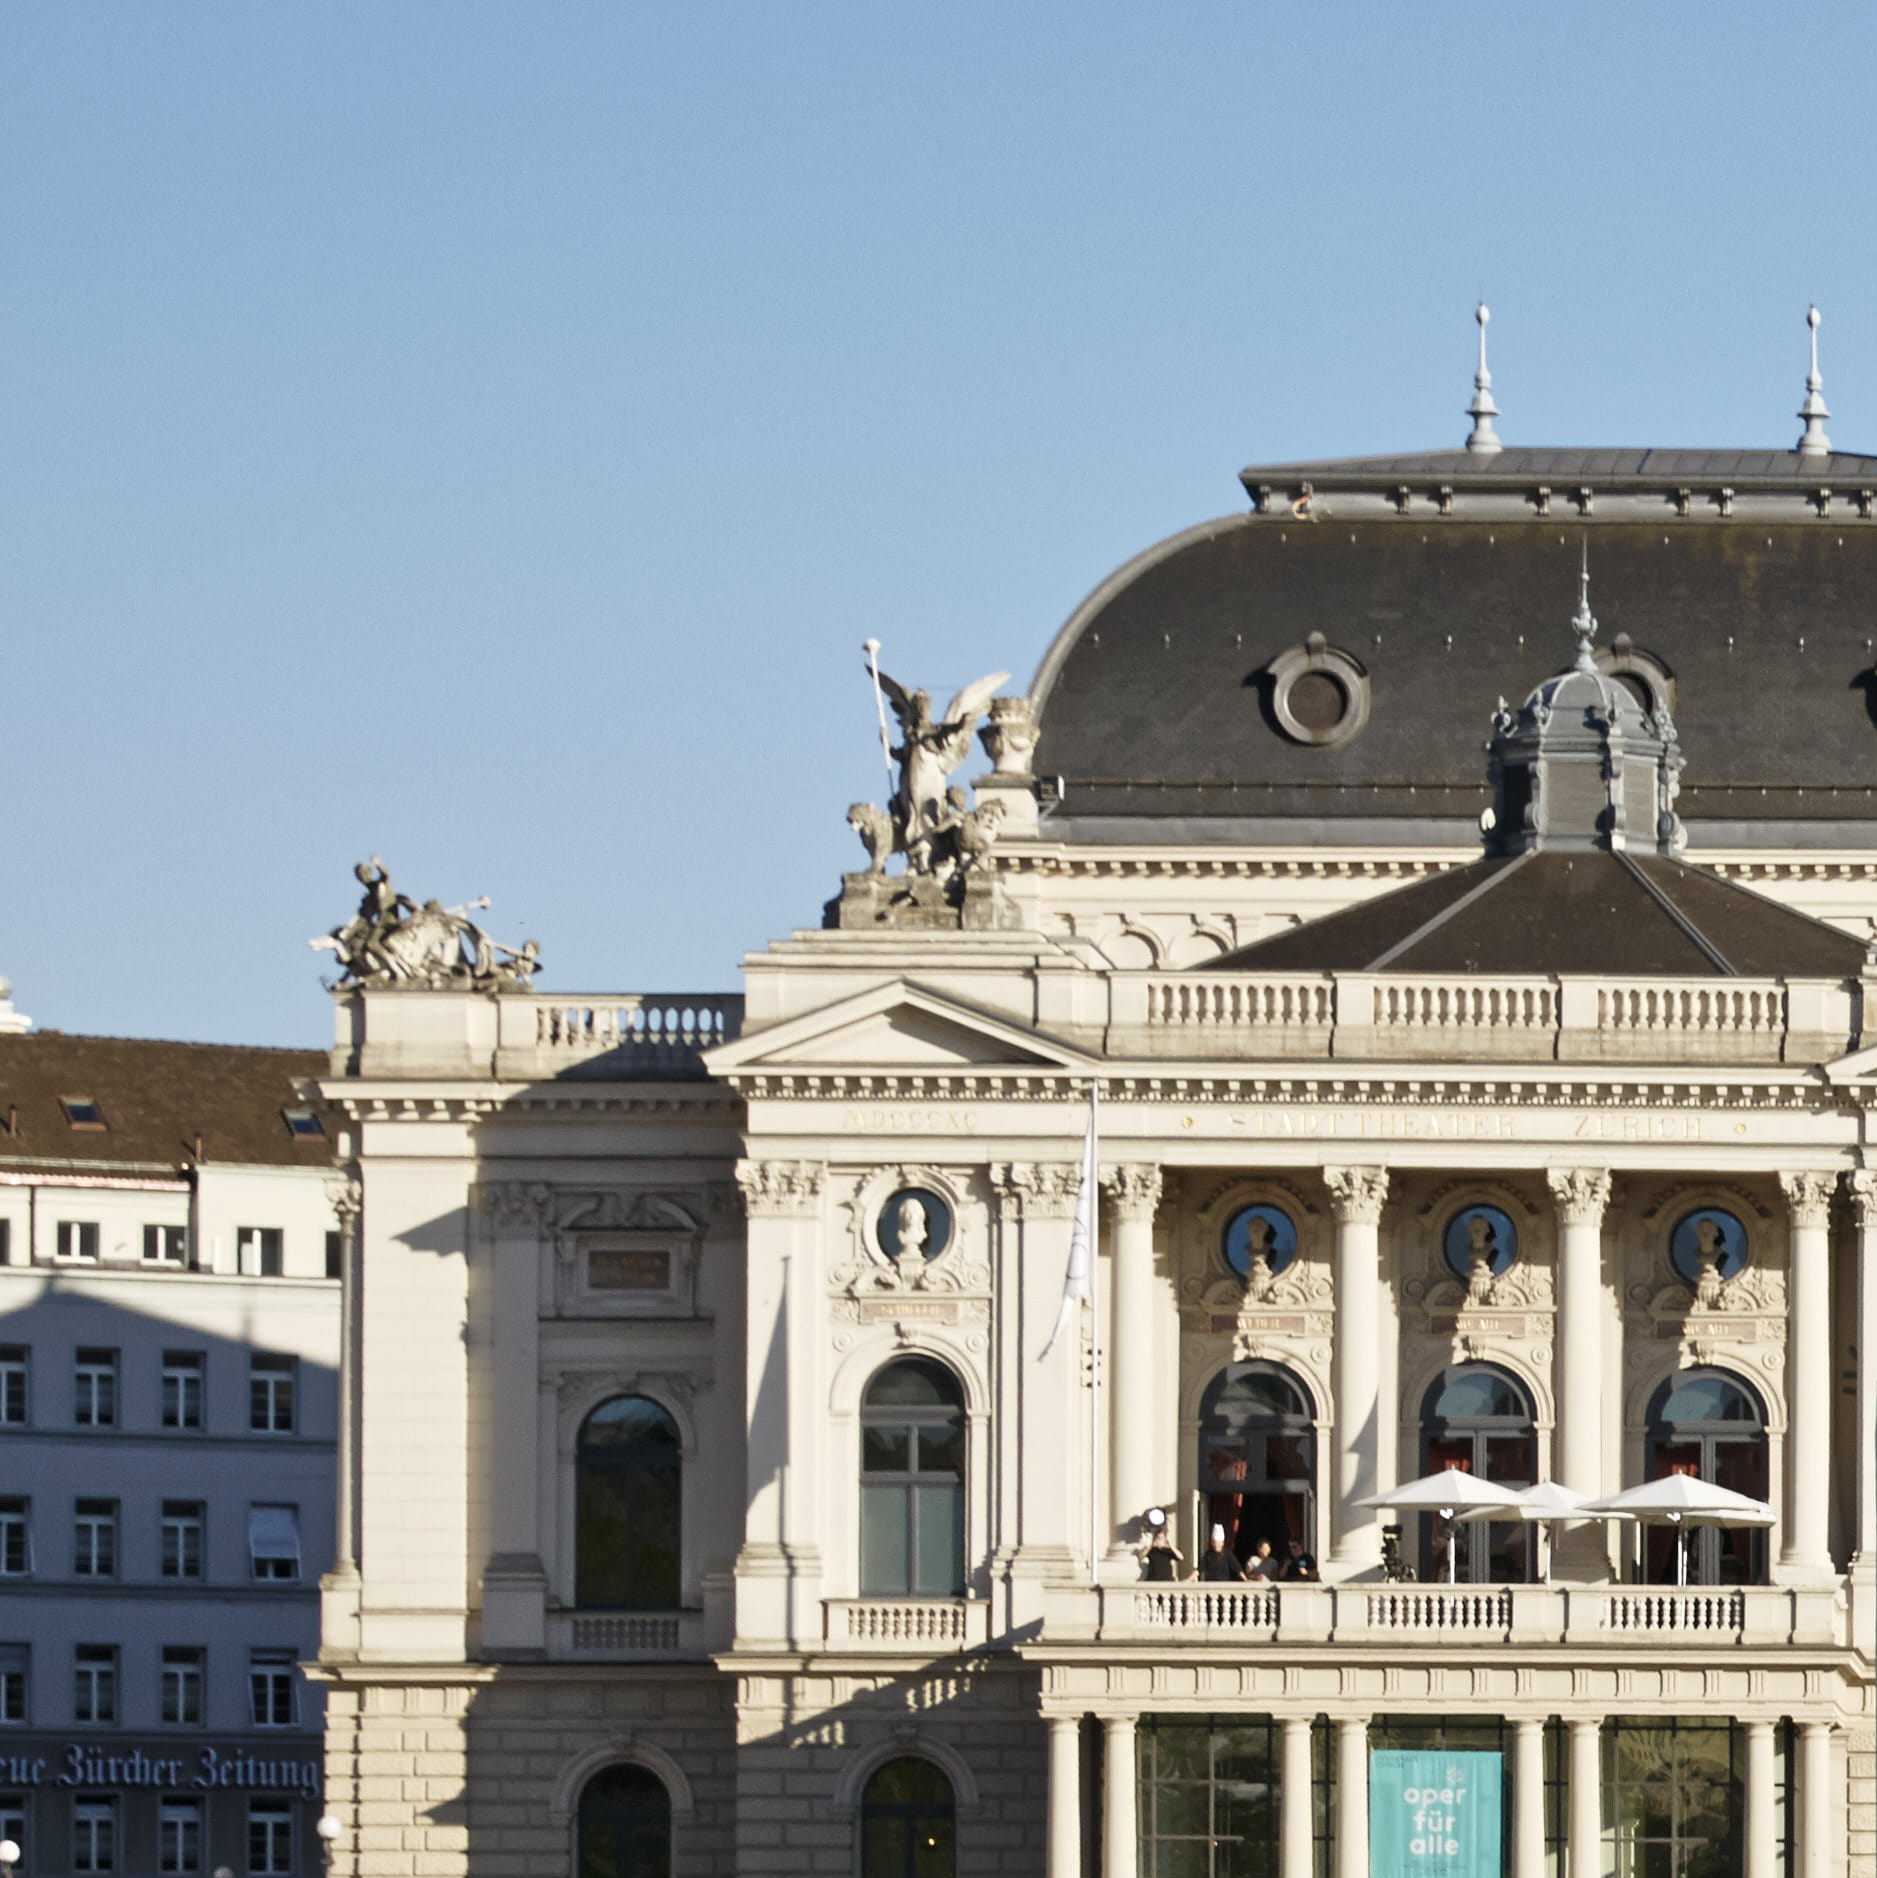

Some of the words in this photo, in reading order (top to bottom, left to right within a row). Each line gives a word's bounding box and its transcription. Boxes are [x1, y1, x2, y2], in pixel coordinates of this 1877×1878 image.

[56, 1744, 184, 1788] Zürcher
[193, 1746, 320, 1798] Zeitung
[1403, 1787, 1467, 1810] oper
[1413, 1809, 1456, 1833] für
[1409, 1834, 1460, 1856] alle
